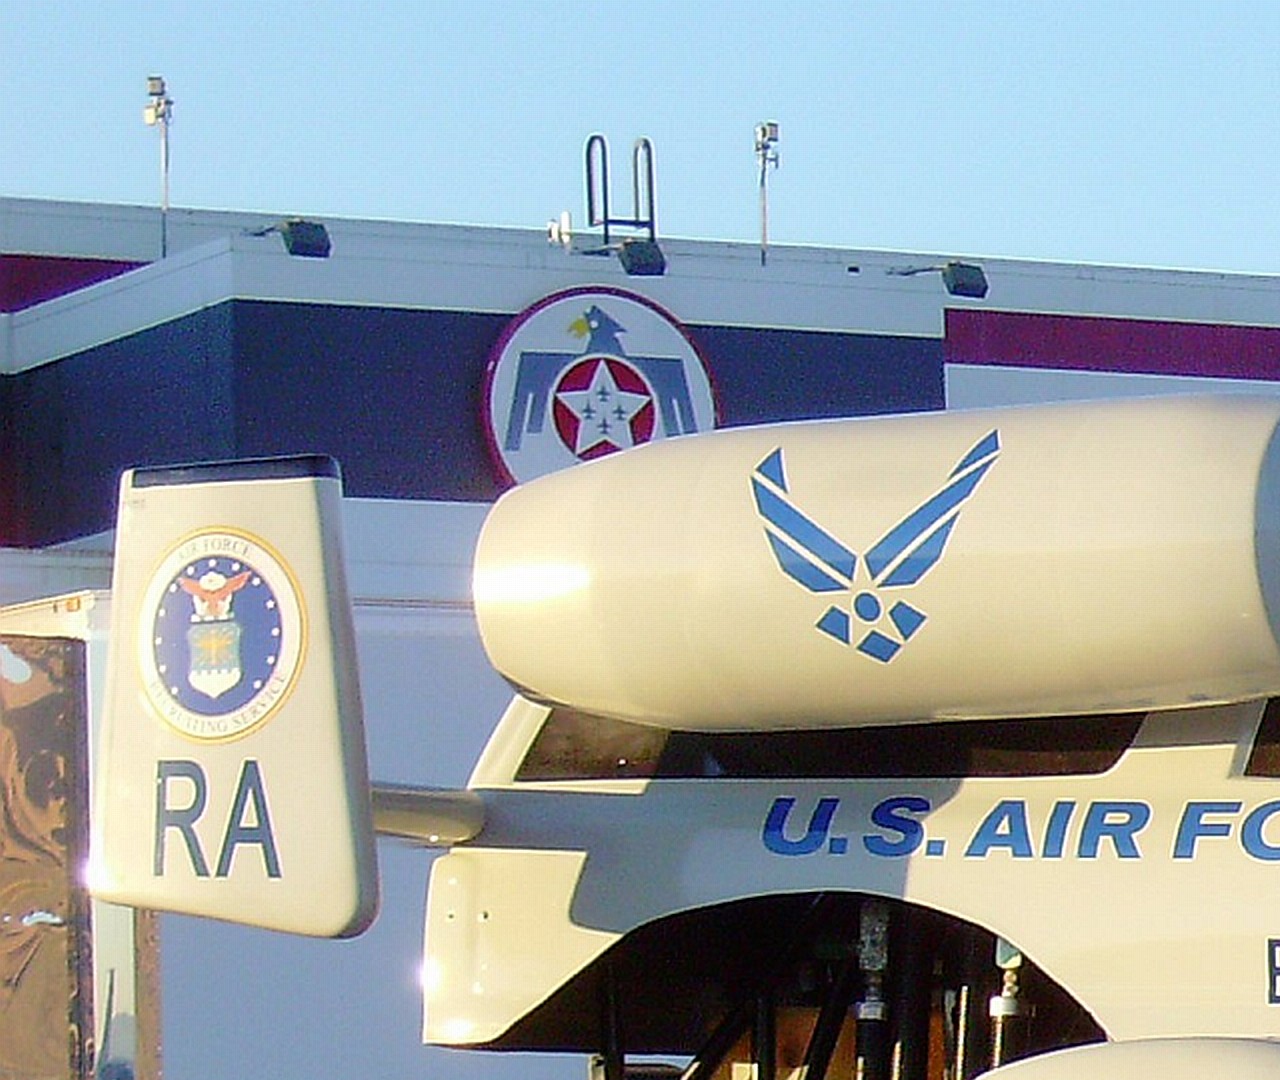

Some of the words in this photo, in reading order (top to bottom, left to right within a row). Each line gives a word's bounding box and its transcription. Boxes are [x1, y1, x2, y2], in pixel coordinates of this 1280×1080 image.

[202, 538, 251, 557] FORCE
[232, 674, 287, 728] SERVICE
[152, 758, 283, 879] RA
[761, 794, 945, 858] U.S.
[965, 797, 1151, 859] AIR
